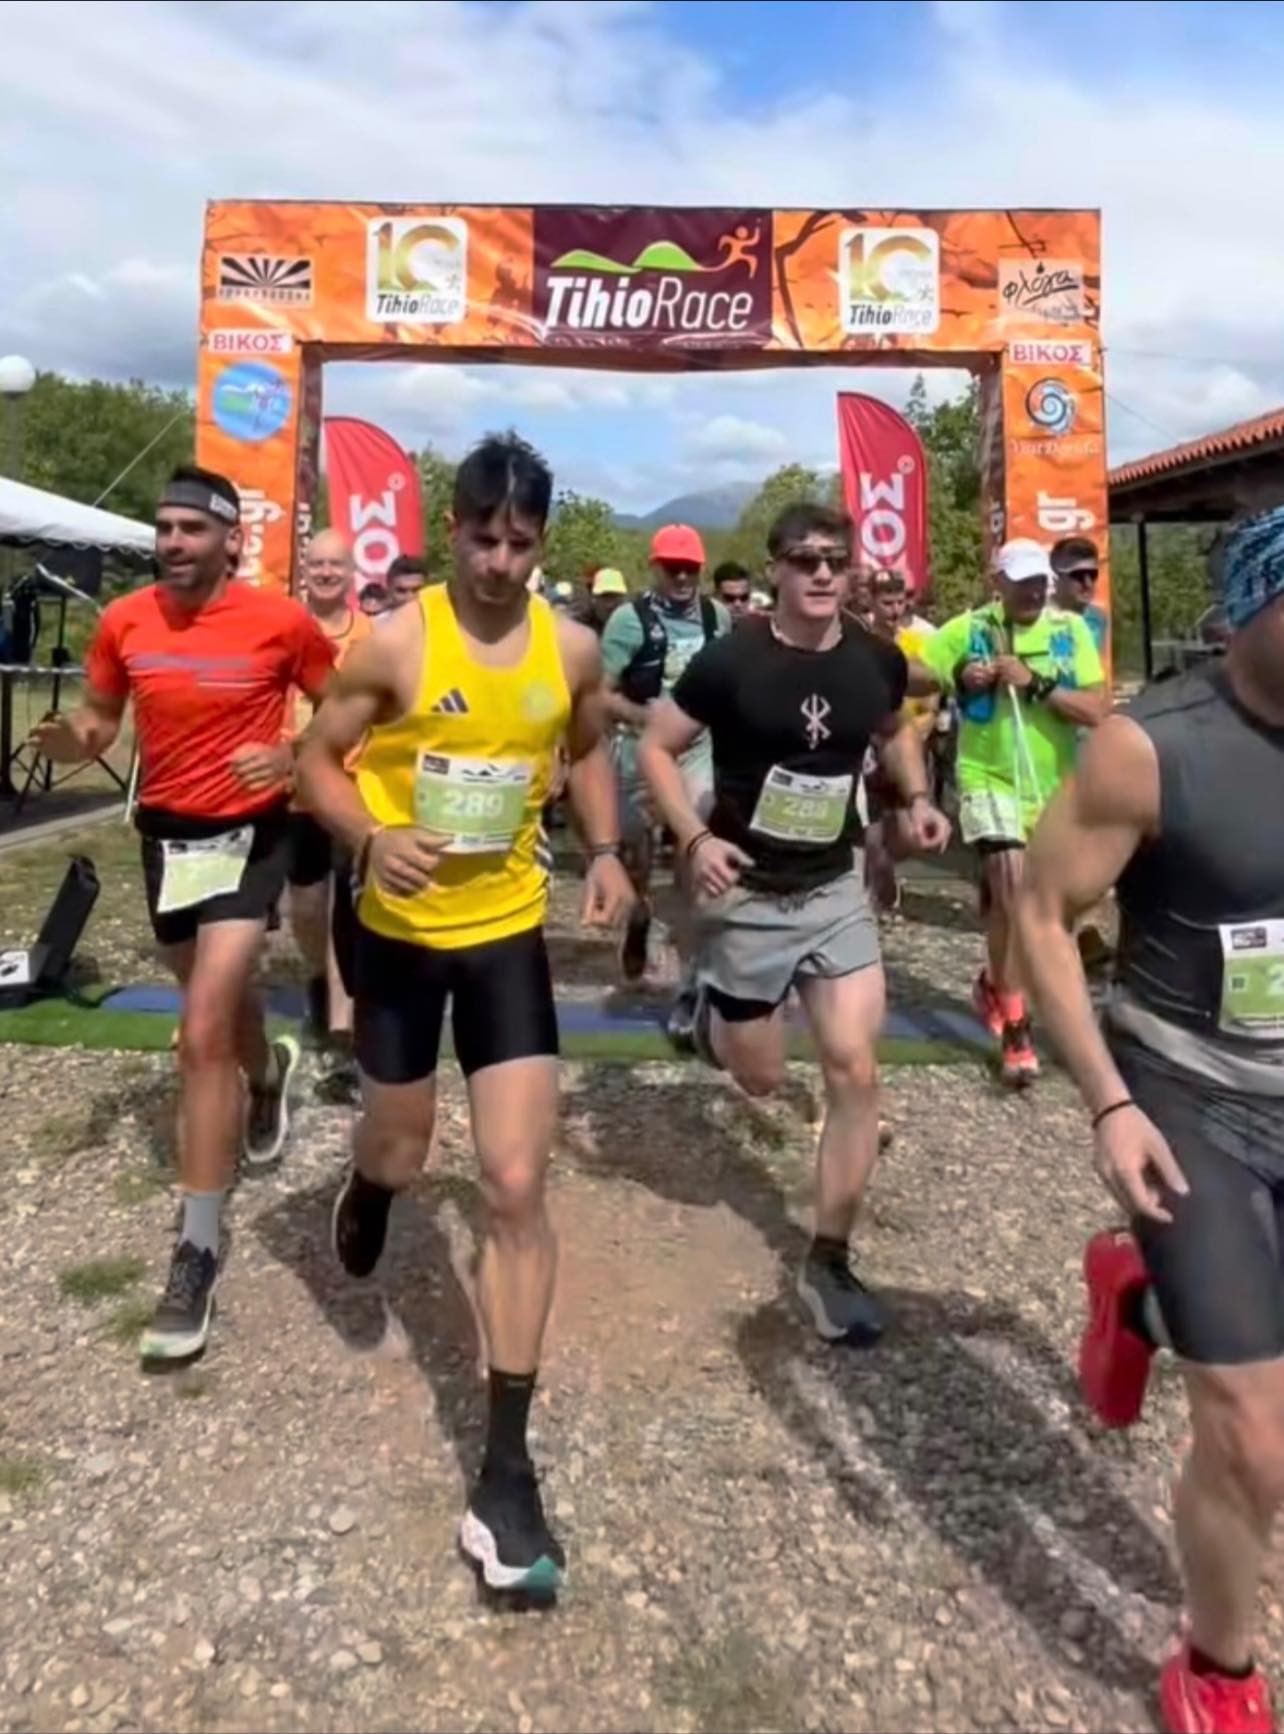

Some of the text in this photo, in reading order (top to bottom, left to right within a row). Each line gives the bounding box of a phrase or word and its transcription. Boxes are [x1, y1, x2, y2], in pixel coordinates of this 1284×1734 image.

[376, 294, 459, 314] TihioRace
[544, 276, 753, 330] TihioRace
[849, 304, 932, 325] TihioRace
[213, 334, 285, 351] ΒΙΚΟΣ
[1013, 344, 1083, 362] ΒΙΚΟΣ
[441, 788, 504, 818] 289
